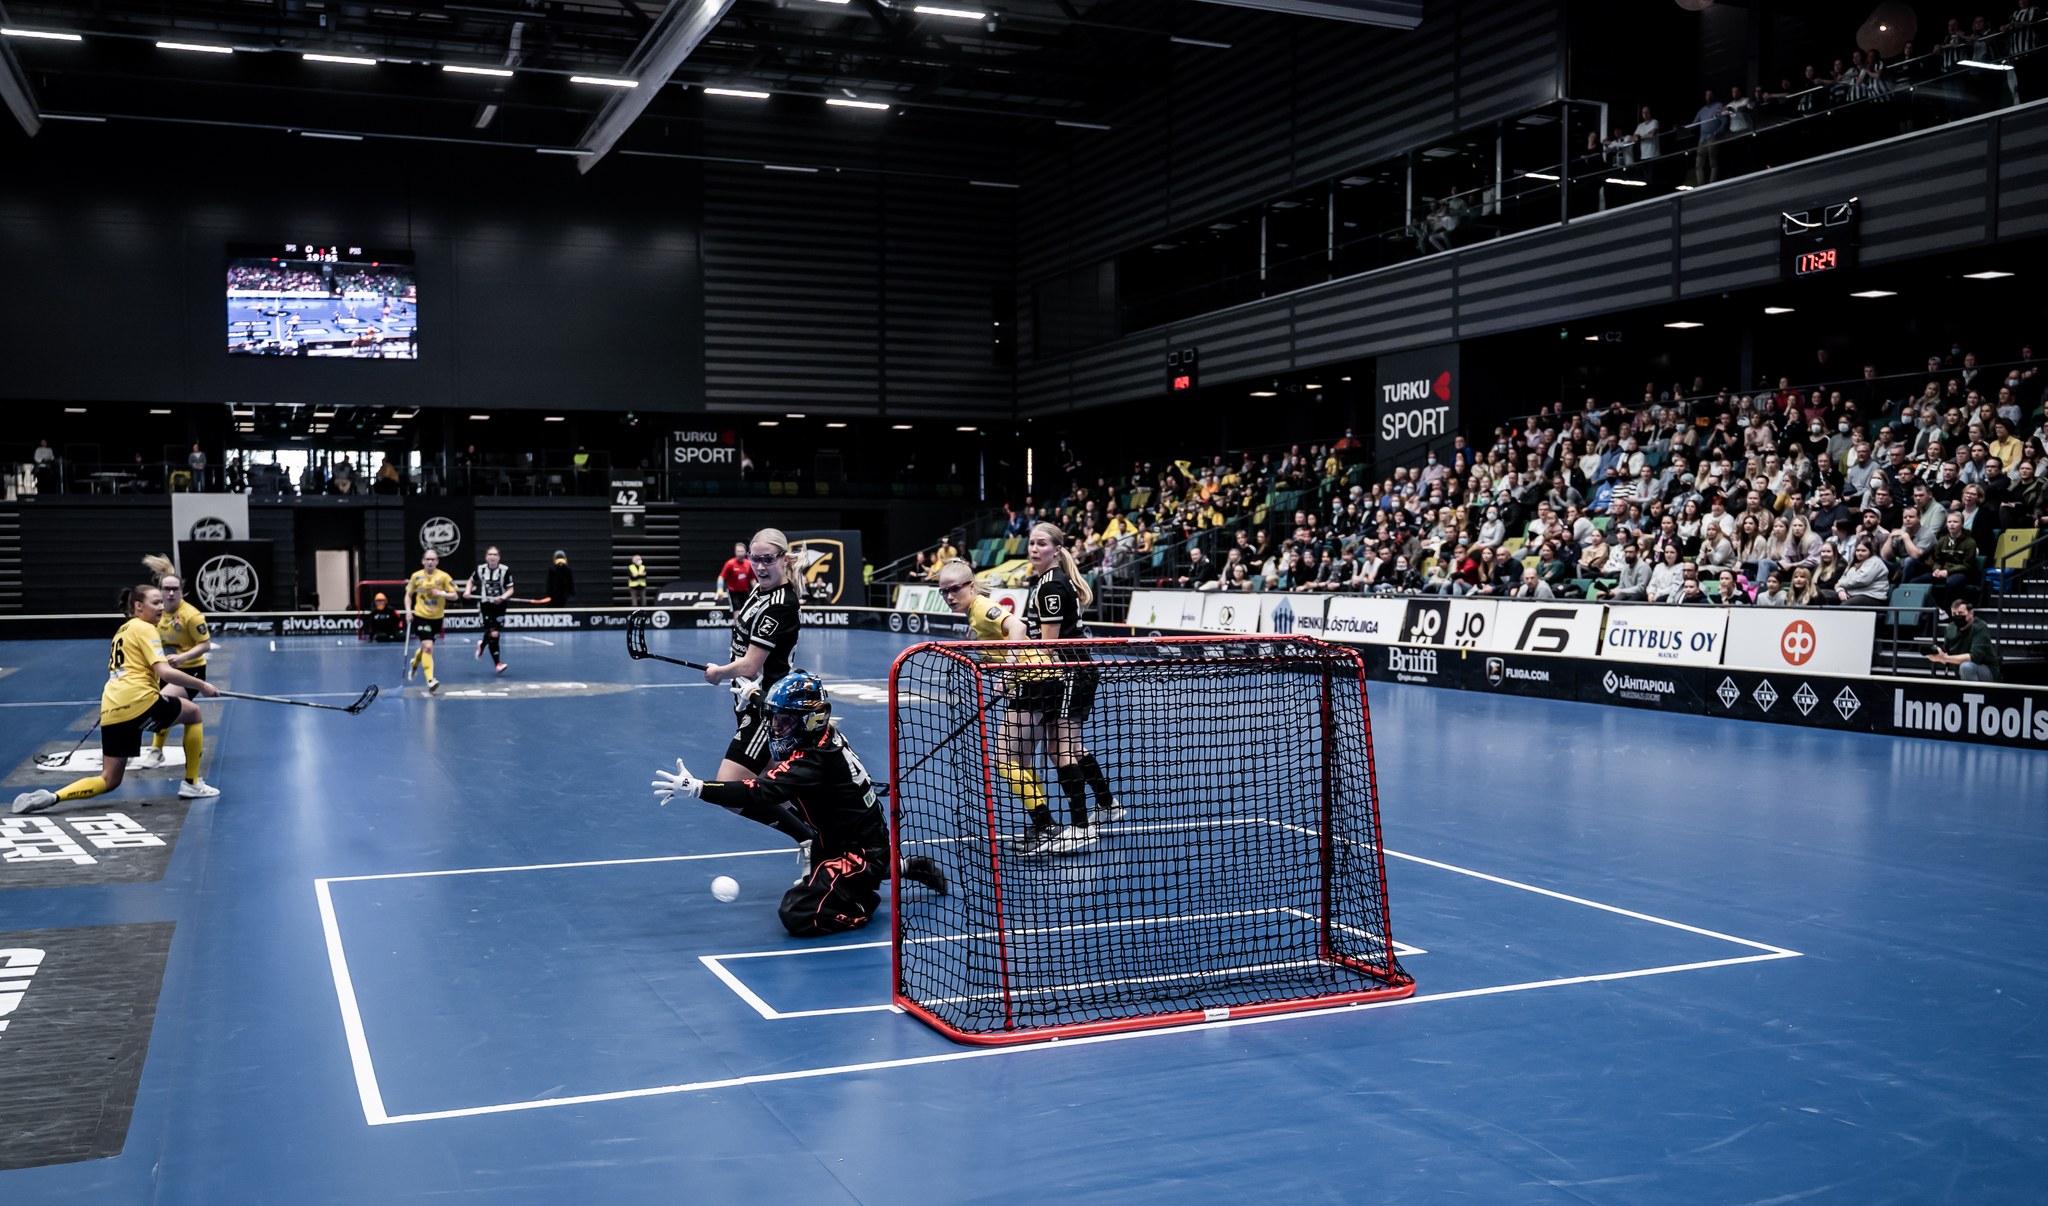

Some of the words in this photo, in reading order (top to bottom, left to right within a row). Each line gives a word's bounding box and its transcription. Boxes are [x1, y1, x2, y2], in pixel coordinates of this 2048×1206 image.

[329, 246, 338, 255] 1
[1801, 249, 1837, 272] 17:29
[1382, 379, 1430, 403] TURKU
[1381, 405, 1449, 441] SPORT
[673, 431, 717, 443] TURKU
[674, 447, 736, 463] SPORT
[616, 490, 639, 505] 42
[657, 592, 699, 601] FAT
[223, 621, 274, 631] PIPE
[825, 612, 849, 625] LINE
[1410, 608, 1441, 637] JO
[1456, 612, 1485, 638] JO
[1608, 628, 1683, 650] CITYBUS
[1690, 632, 1718, 653] OY
[1505, 667, 1550, 682] FLIIGA.COM
[1619, 675, 1676, 694] LÄHITAPIOLA
[1894, 688, 2048, 741] InnoTools
